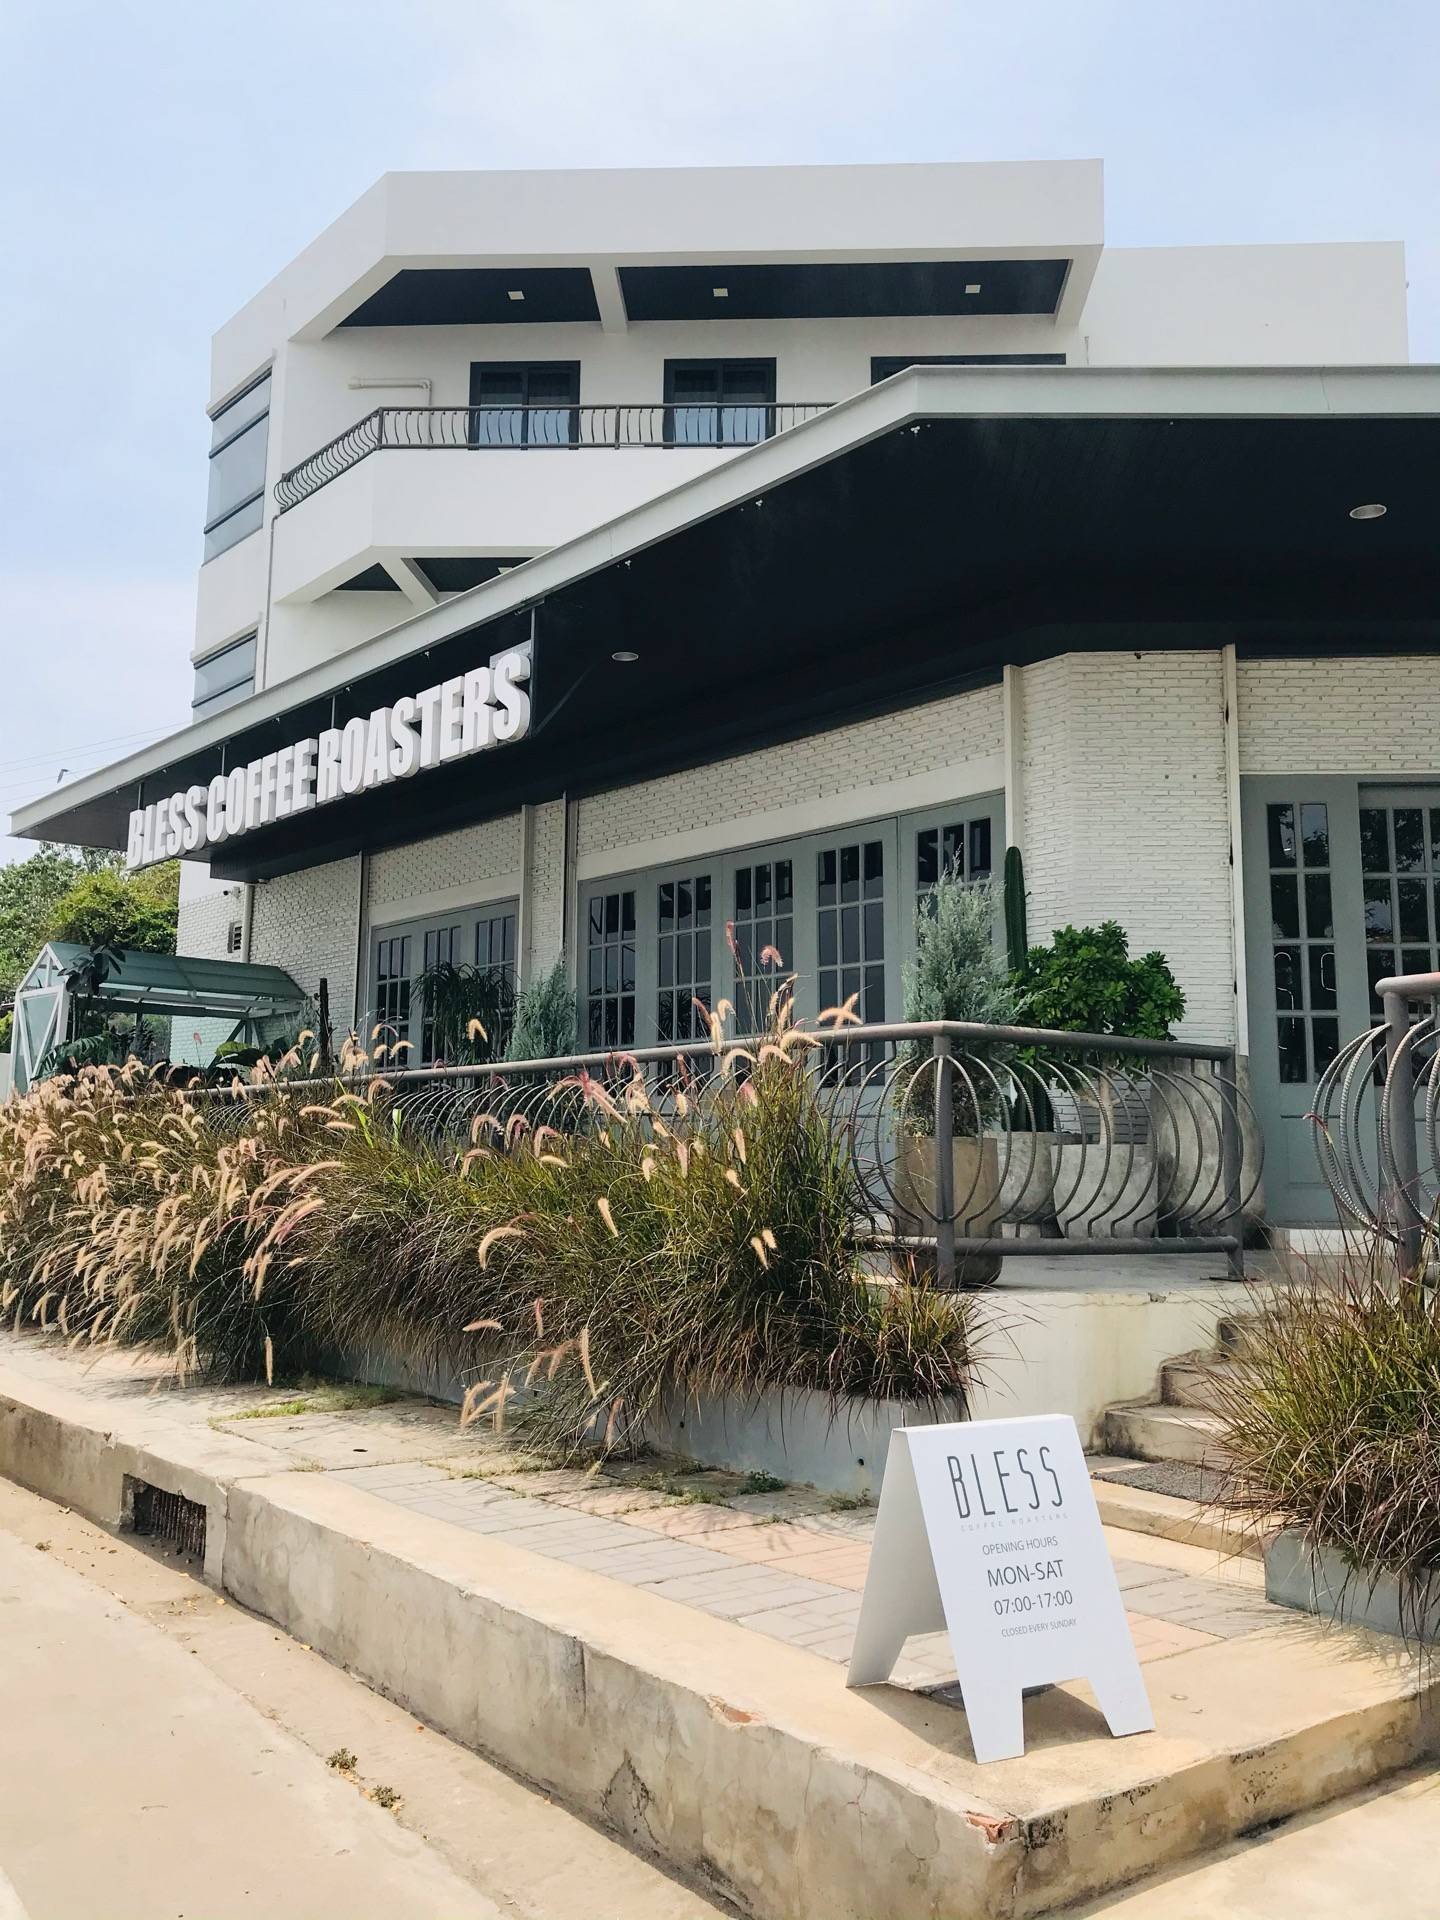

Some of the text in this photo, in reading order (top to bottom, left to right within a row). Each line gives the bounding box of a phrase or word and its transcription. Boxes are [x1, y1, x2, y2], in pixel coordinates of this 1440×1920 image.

[126, 653, 532, 871] BLESS COFFEE ROASTERS
[947, 1446, 1063, 1519] BLESS
[982, 1536, 1058, 1556] OPENING HOURS
[987, 1559, 1064, 1588] MON-SAT
[994, 1589, 1073, 1616] 07:00-17:00
[1001, 1617, 1077, 1638] CLOSED EVERY SUNDAY
